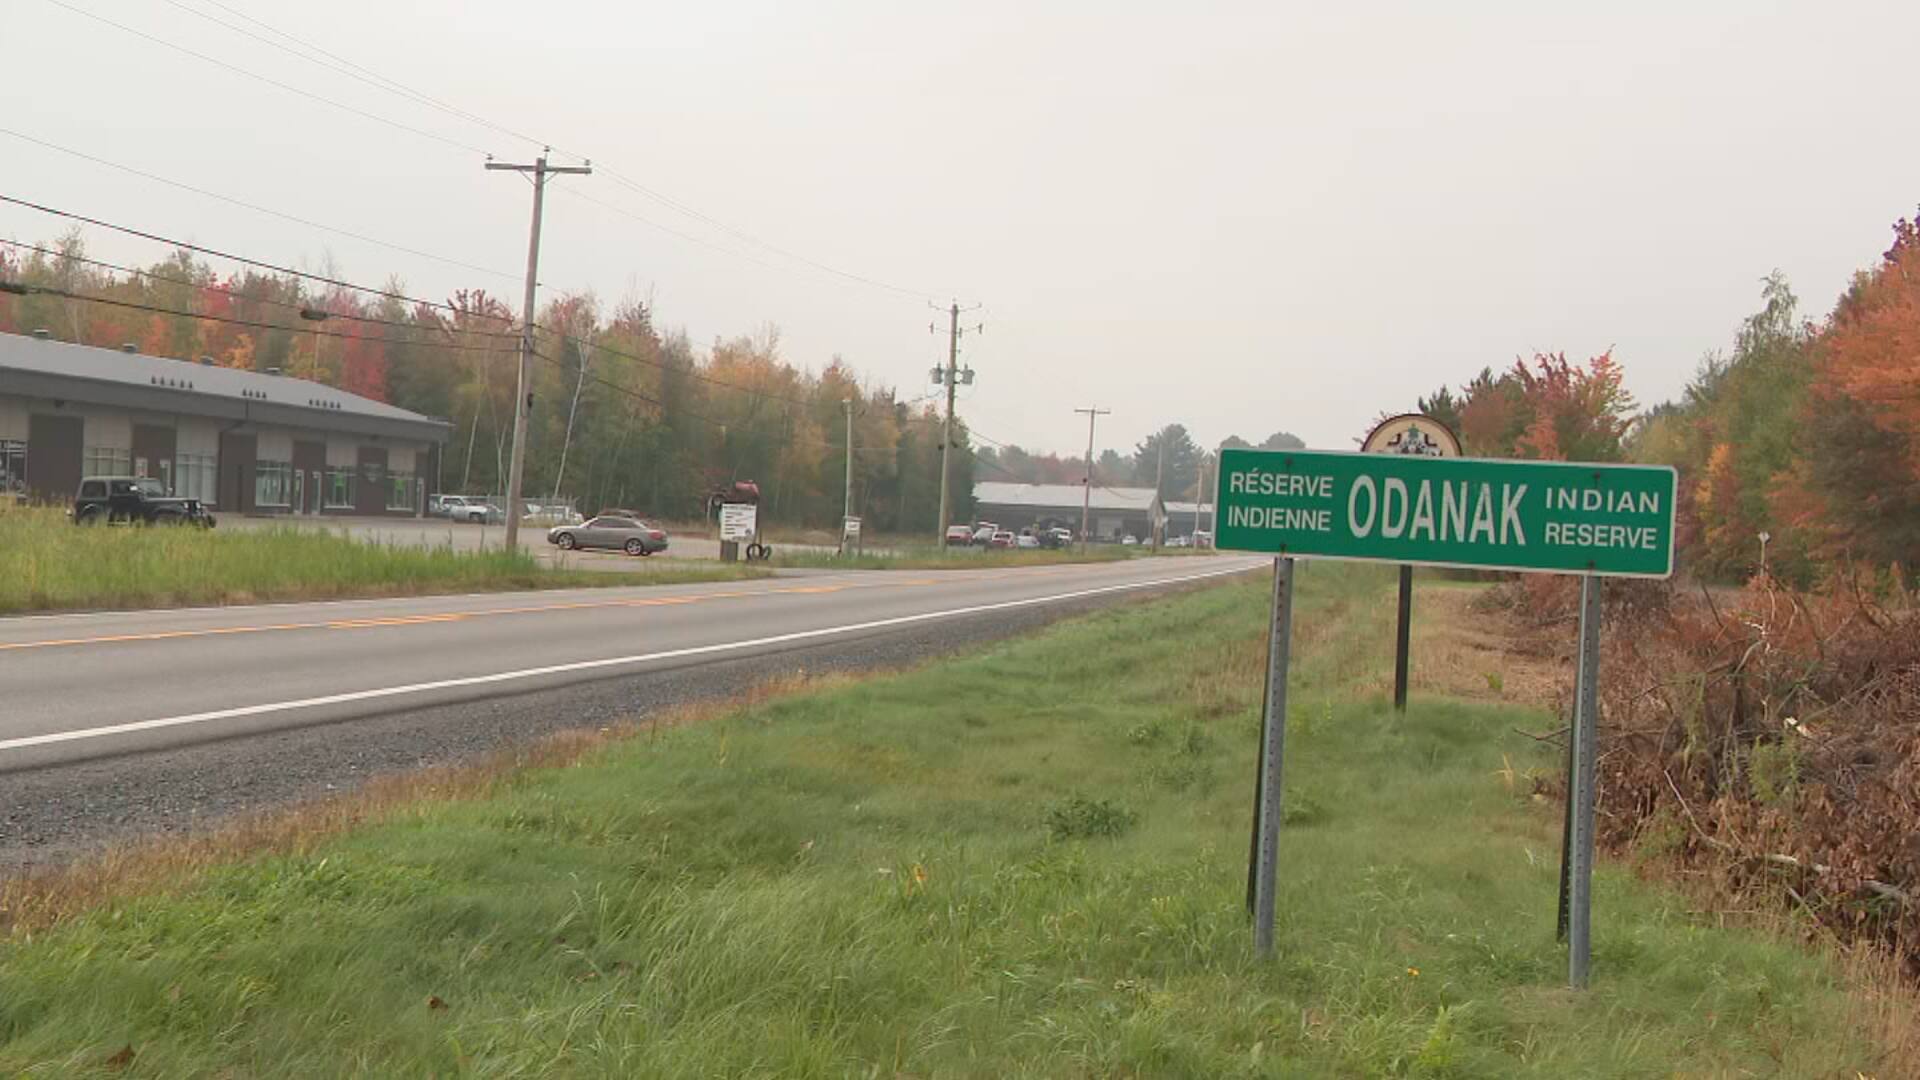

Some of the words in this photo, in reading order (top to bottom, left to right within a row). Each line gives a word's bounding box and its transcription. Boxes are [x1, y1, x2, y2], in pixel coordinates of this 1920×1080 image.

[1229, 468, 1333, 497] RÉSERVE
[1347, 474, 1528, 545] ODANAK
[1545, 487, 1660, 513] INDIAN
[1227, 506, 1331, 532] INDIENNE
[1545, 522, 1657, 550] RESERVE
